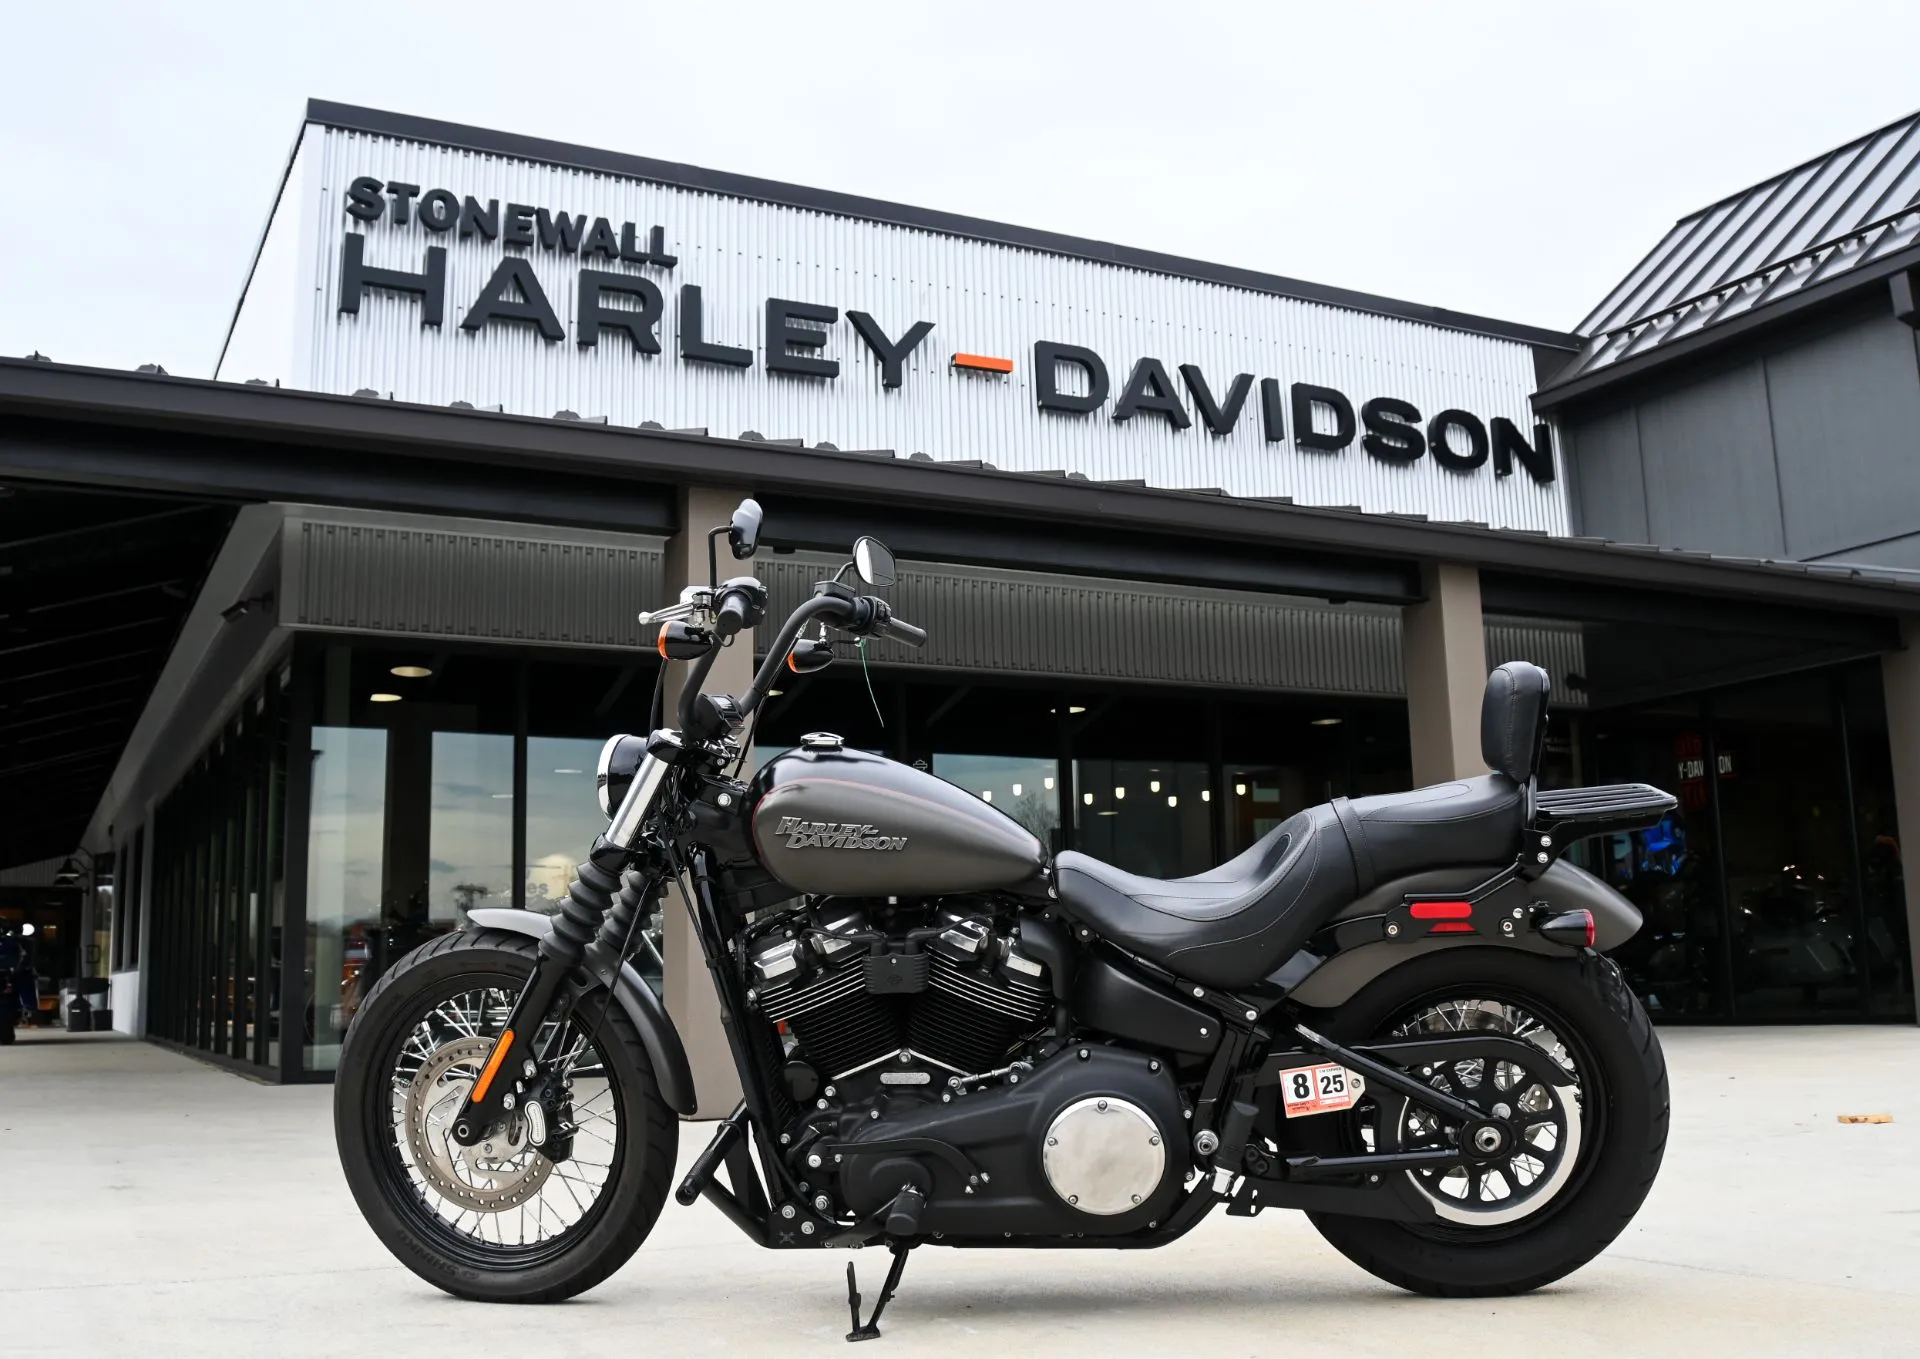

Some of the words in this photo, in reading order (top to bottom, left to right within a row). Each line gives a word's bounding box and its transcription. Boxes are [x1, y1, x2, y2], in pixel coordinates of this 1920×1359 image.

[346, 176, 678, 269] STONEWALL
[786, 834, 908, 850] DAVIDSON
[1293, 1073, 1310, 1099] 8
[1320, 1074, 1345, 1095] 25
